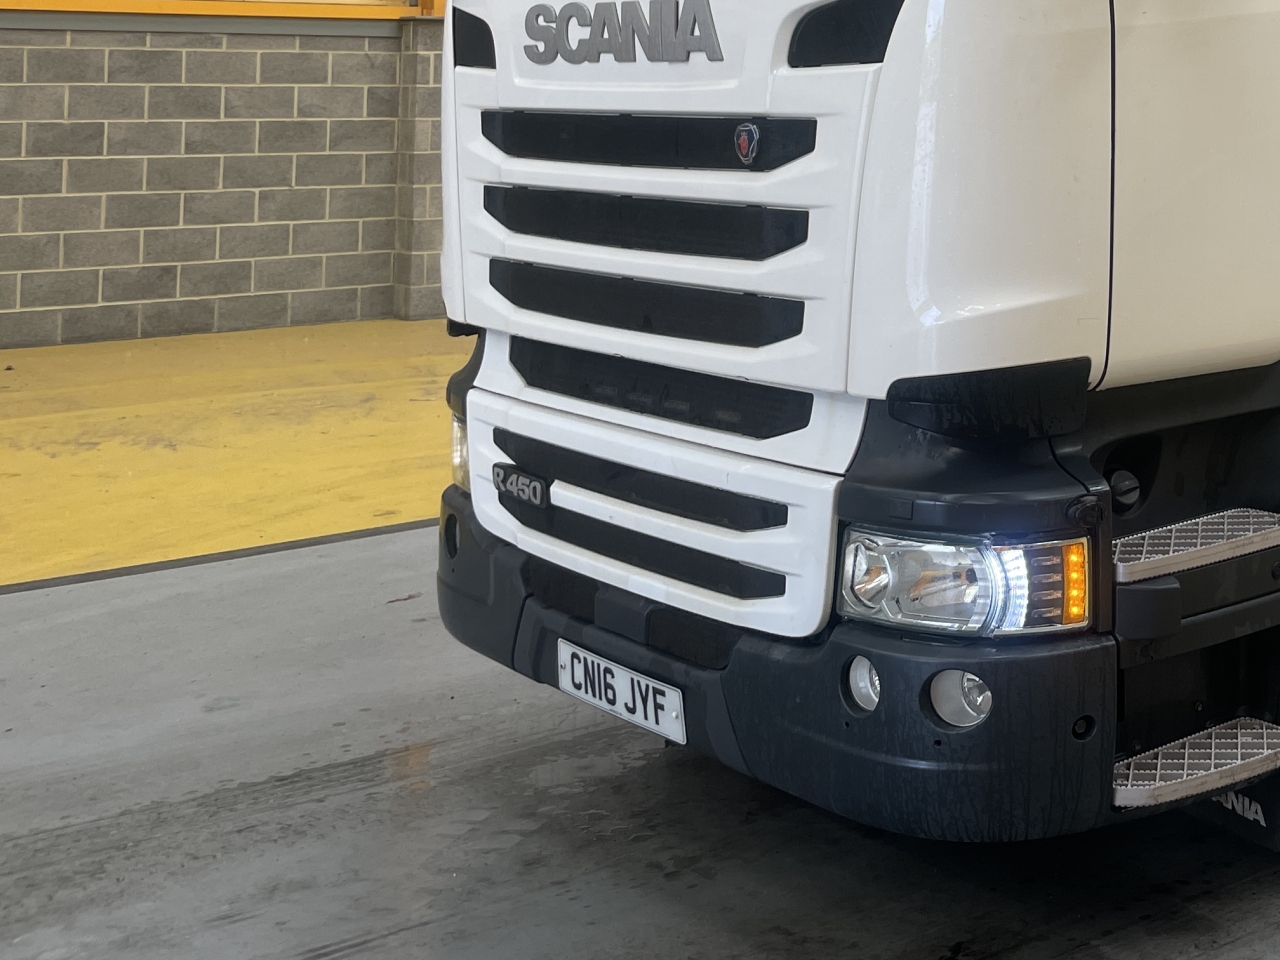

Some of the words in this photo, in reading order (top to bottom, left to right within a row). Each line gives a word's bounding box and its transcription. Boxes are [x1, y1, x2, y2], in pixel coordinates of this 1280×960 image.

[493, 467, 506, 492] R
[506, 473, 542, 505] 450
[570, 651, 617, 707] CN16
[624, 677, 666, 726] JYF
